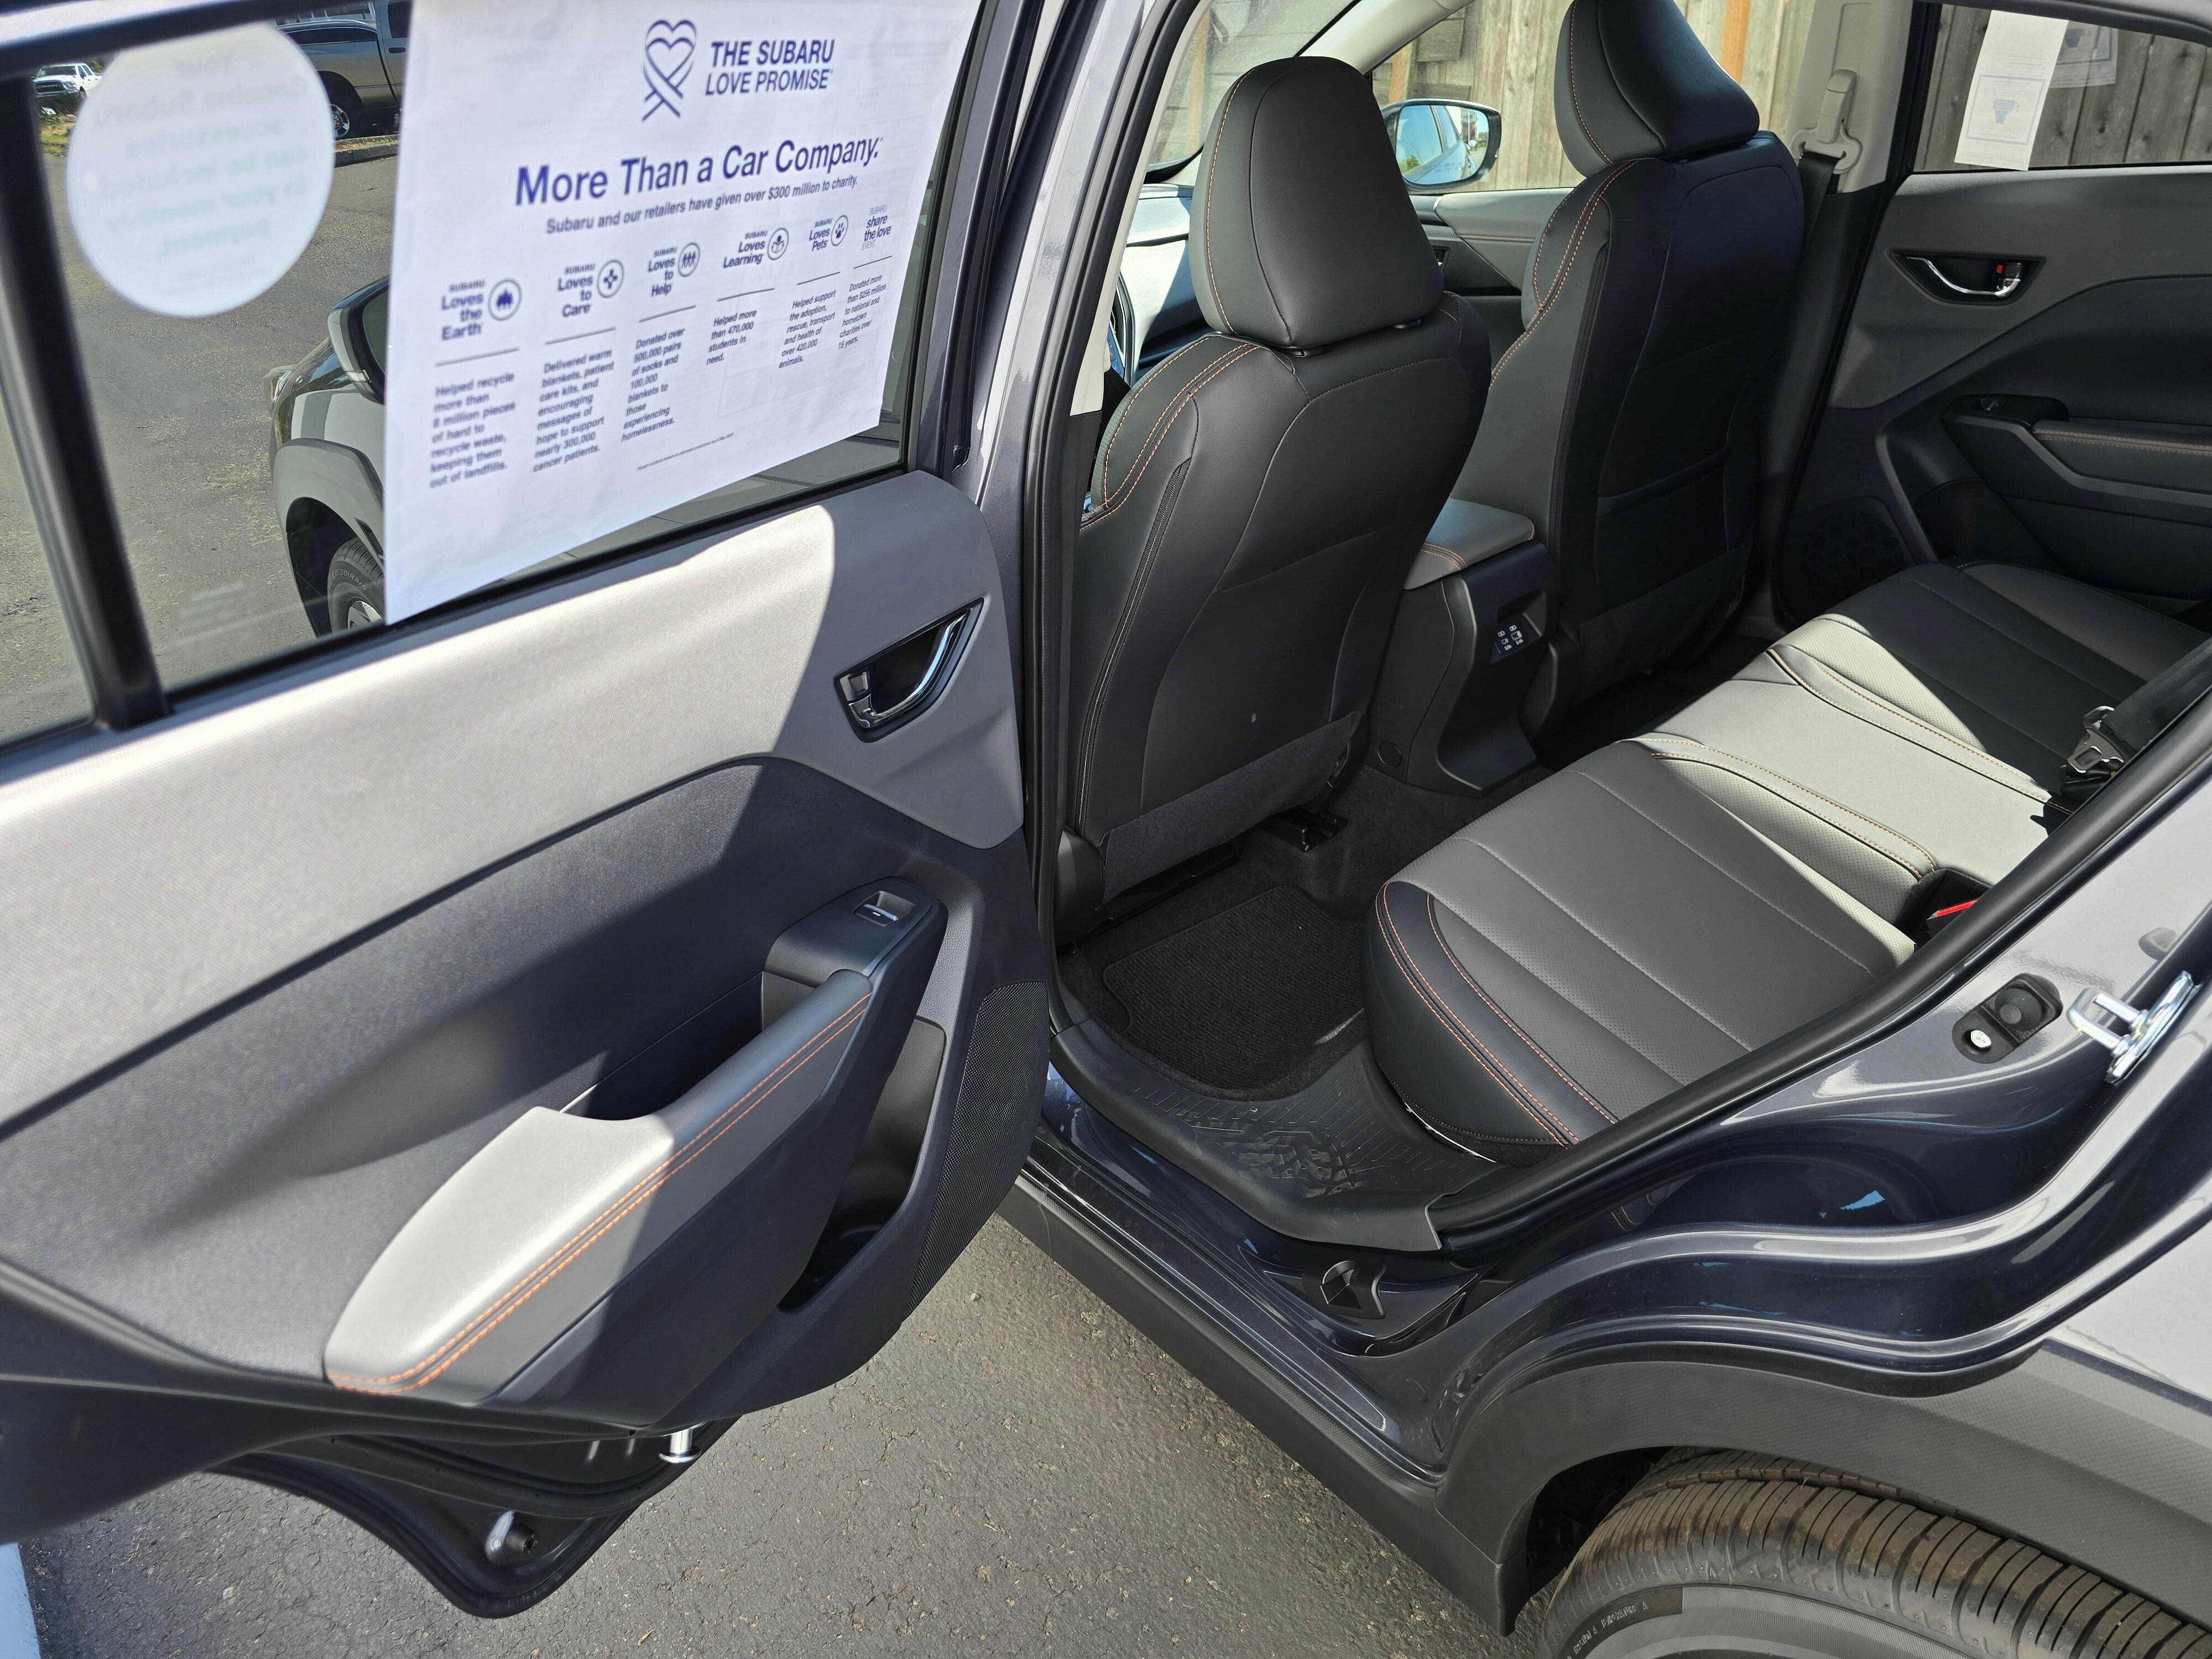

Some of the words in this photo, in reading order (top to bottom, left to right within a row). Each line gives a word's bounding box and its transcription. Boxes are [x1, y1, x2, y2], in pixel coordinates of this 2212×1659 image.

[711, 40, 752, 67] THE
[757, 39, 835, 65] SUBARU
[705, 72, 752, 96] LOVE
[755, 69, 831, 93] PROMISE
[515, 164, 608, 206] More
[620, 155, 688, 195] Than
[696, 157, 713, 184] a
[723, 145, 769, 179] Car
[546, 218, 594, 234] Subaru
[598, 211, 620, 228] and
[623, 210, 643, 223] our
[644, 201, 686, 220] retailers
[689, 197, 713, 211] have
[715, 193, 741, 210] given
[744, 190, 766, 203] over
[768, 185, 790, 200] $300
[792, 182, 820, 197] million
[822, 179, 830, 191] to
[832, 175, 858, 190] charity.
[870, 204, 888, 216] SUBARU
[814, 217, 833, 228] SUBARU
[866, 215, 888, 229] share
[745, 230, 768, 239] SUBARU
[808, 228, 830, 241] Loves
[864, 229, 876, 242] the
[877, 226, 891, 238] love
[653, 246, 677, 258] SUBARU
[738, 241, 765, 253] Loves
[812, 240, 827, 252] Pets
[862, 239, 877, 251] EVENT
[565, 263, 595, 275] SUBARU
[648, 258, 675, 273] Loves
[723, 253, 763, 269] Learning
[558, 276, 593, 291] Loves
[664, 269, 674, 281] to
[849, 278, 870, 292] Donated
[870, 275, 883, 284] more
[449, 279, 484, 293] SUBARU
[580, 289, 592, 301] to
[651, 284, 672, 298] Help
[847, 295, 858, 304] than
[870, 284, 886, 295] million
[441, 293, 484, 311] Loves
[792, 295, 813, 309] Helped
[814, 289, 836, 303] support
[851, 299, 870, 313] national
[870, 296, 880, 305] and
[460, 308, 482, 322] the
[562, 304, 591, 318] Care
[713, 312, 738, 327] Helped
[739, 310, 757, 320] more
[789, 313, 799, 321] the
[801, 305, 827, 318] adoption,
[842, 312, 867, 327] hometown
[441, 322, 482, 341] Earth
[711, 330, 726, 340] than
[728, 321, 754, 335] 470,000
[786, 321, 808, 333] rescue,
[810, 312, 836, 326] transport
[839, 325, 860, 338] charities
[861, 320, 872, 330] over
[636, 332, 666, 349] Donated
[668, 328, 685, 340] over
[708, 337, 738, 353] students
[739, 335, 747, 344] in
[784, 335, 796, 345] and
[797, 329, 814, 341] health
[815, 326, 822, 335] of
[838, 340, 845, 349] 15
[844, 336, 858, 348] years.
[634, 346, 661, 363] 500,000
[663, 341, 681, 355] pairs
[781, 347, 795, 357] over
[796, 338, 818, 352] 420,000
[544, 354, 587, 374] Delivered
[589, 349, 612, 362] warm
[632, 365, 640, 377] of
[641, 360, 662, 373] socks
[664, 354, 679, 366] and
[706, 352, 724, 366] need.
[779, 355, 804, 368] animals.
[584, 361, 614, 379] patient
[435, 380, 474, 397] Helped
[477, 372, 514, 388] recycle
[540, 390, 559, 402] care
[582, 378, 599, 391] and
[630, 373, 658, 390] 100,000
[628, 386, 659, 404] blankets
[661, 383, 668, 392] to
[434, 400, 462, 413] more
[466, 394, 489, 406] than
[538, 394, 593, 417] encouraging
[626, 403, 646, 416] those
[443, 410, 479, 426] million
[482, 402, 515, 419] pieces
[537, 411, 581, 431] messages
[583, 406, 593, 417] of
[623, 406, 670, 430] experiencing
[432, 431, 443, 444] of
[447, 425, 471, 440] hard
[474, 424, 485, 434] to
[536, 432, 557, 445] hope
[561, 427, 568, 437] to
[571, 416, 604, 434] support
[622, 417, 675, 442] homelessness.
[431, 442, 470, 458] recycle
[535, 442, 561, 459] nearly
[564, 431, 596, 450] 300,000
[430, 455, 473, 473] keeping
[476, 448, 502, 462] them
[533, 456, 562, 472] cancer
[564, 444, 600, 464] patients.
[430, 475, 447, 488] out
[450, 471, 462, 482] of
[465, 461, 507, 479] landfills.
